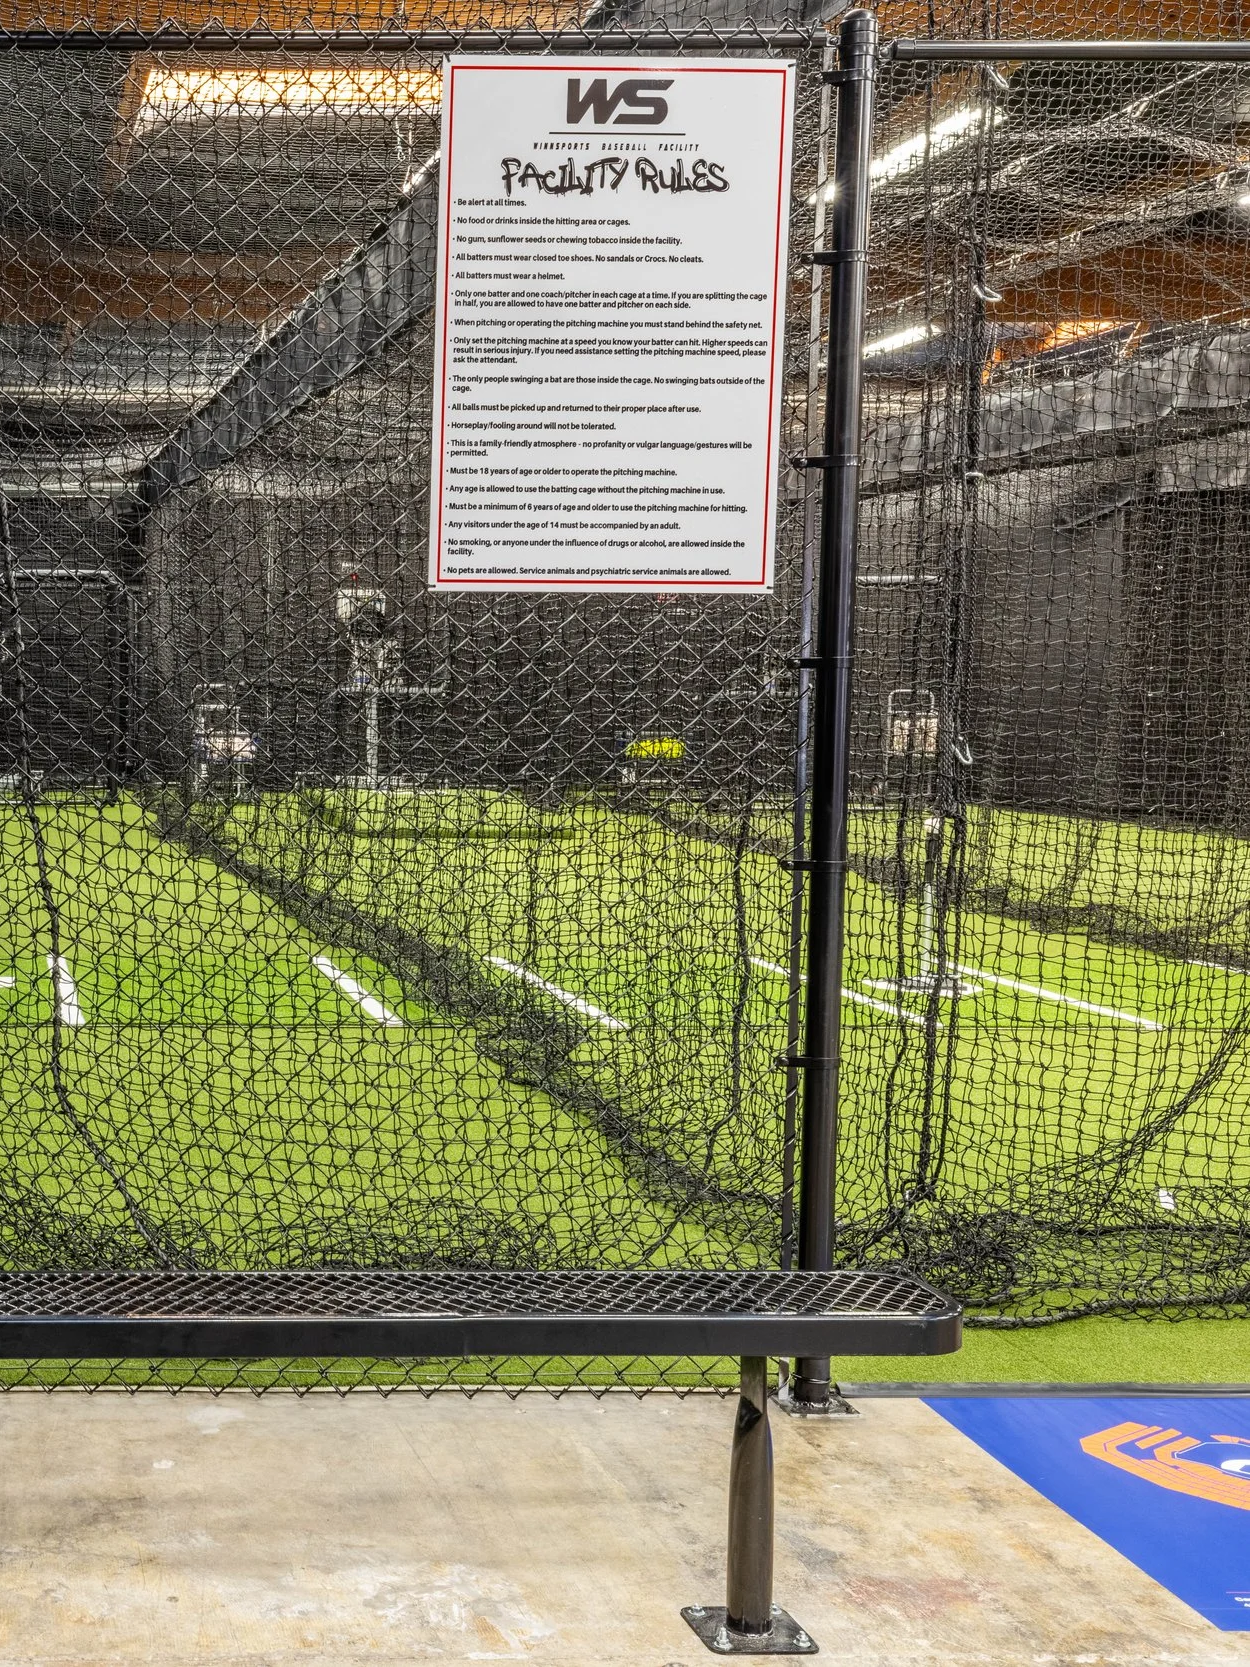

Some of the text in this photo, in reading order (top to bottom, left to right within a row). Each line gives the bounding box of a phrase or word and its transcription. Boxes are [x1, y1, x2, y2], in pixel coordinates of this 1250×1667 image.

[568, 78, 674, 124] WS
[533, 142, 700, 151] WINNSPORTS BASEBALL FACILITY
[501, 157, 730, 196] FACILITY RULES
[467, 198, 485, 206] alert
[494, 198, 503, 206] all
[504, 198, 526, 206] times.
[456, 216, 467, 224] No
[468, 216, 485, 224] food
[493, 216, 518, 224] drinks
[519, 216, 541, 224] inside
[555, 217, 580, 226] hitting
[606, 219, 630, 227] cages.
[467, 236, 486, 244] gum,
[487, 234, 524, 243] sunflower
[524, 235, 546, 243] seeds
[555, 235, 587, 245] chewing
[588, 235, 618, 244] tobacco
[618, 236, 641, 244] inside
[641, 236, 654, 244] the
[655, 236, 682, 246] facility.
[455, 252, 465, 260] All
[466, 253, 493, 261] batters
[532, 253, 556, 261] closed
[595, 254, 605, 262] No
[606, 254, 634, 262] sandals
[644, 254, 667, 262] Crocs.
[465, 271, 492, 279] batters
[537, 272, 565, 280] helmet.
[454, 318, 475, 326] When
[475, 318, 506, 328] pitching
[515, 319, 551, 328] operating
[565, 319, 596, 329] pitching
[597, 319, 628, 327] machine
[629, 321, 643, 329] you
[663, 320, 684, 328] stand
[685, 320, 711, 328] behind
[711, 320, 724, 328] the
[725, 320, 747, 330] safety
[452, 355, 517, 363] ask the attendant.
[451, 385, 471, 393] cage.
[480, 403, 499, 411] must
[499, 403, 509, 411] be
[510, 403, 535, 413] picked
[536, 405, 546, 413] up
[546, 403, 561, 411] and
[603, 404, 620, 412] their
[646, 404, 667, 414] place
[667, 404, 685, 412] after
[451, 421, 515, 431] Horseplay/fooling
[516, 421, 542, 429] around
[543, 421, 556, 429] will
[580, 422, 616, 430] tolerated.
[450, 448, 488, 458] permitted.
[468, 466, 478, 474] be
[489, 468, 510, 476] years
[519, 468, 532, 476] age
[542, 467, 561, 475] older
[570, 468, 599, 477] operate
[599, 467, 612, 475] the
[612, 467, 643, 477] pitching
[644, 468, 677, 476] machine.
[448, 520, 462, 529] Any
[463, 520, 490, 528] visitors
[490, 520, 512, 528] under
[513, 520, 525, 528] the
[526, 522, 540, 530] age
[540, 520, 548, 528] of
[589, 521, 638, 530] accompanied
[639, 521, 649, 531] by
[659, 521, 680, 529] adult.
[447, 547, 474, 556] facility.
[458, 566, 474, 575] pets
[487, 566, 518, 574] allowed.
[519, 566, 546, 574] Service
[546, 566, 575, 574] animals
[590, 567, 631, 576] psychiatric
[631, 567, 658, 575] service
[658, 567, 687, 575] animals
